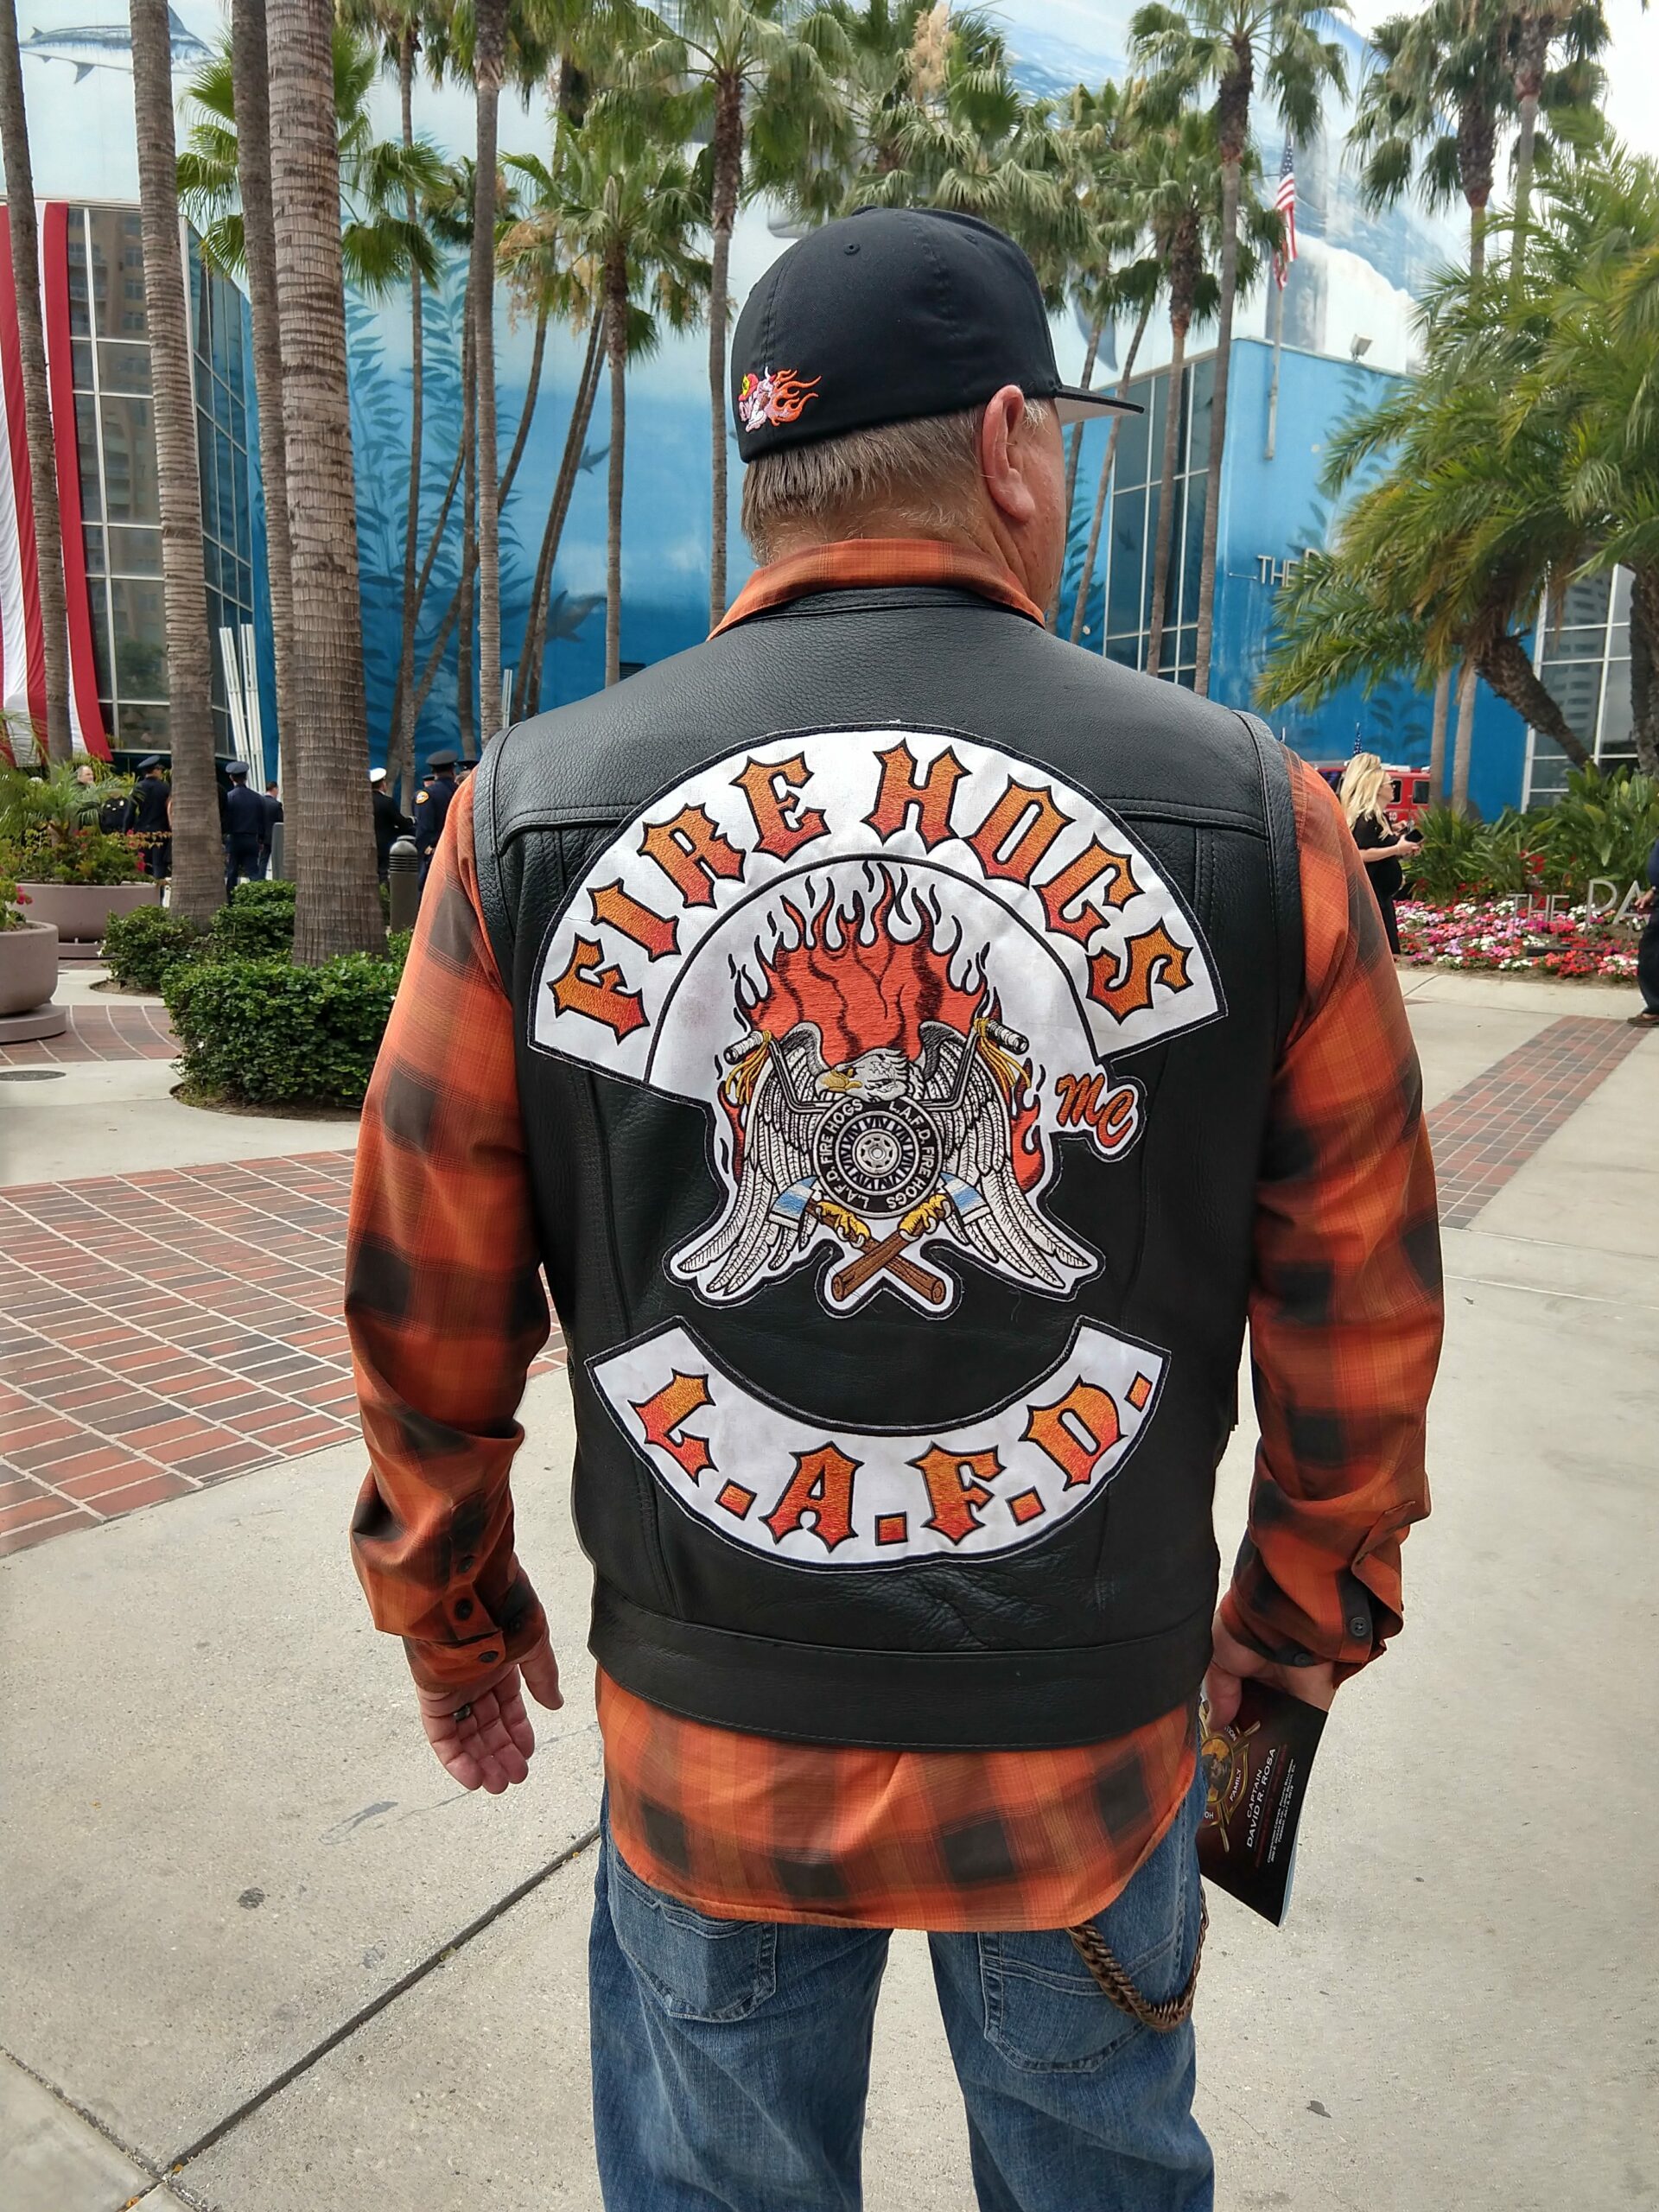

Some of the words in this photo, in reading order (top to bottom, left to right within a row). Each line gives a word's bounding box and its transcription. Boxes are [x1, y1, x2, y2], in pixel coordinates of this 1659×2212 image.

[1257, 555, 1299, 588] THE
[546, 751, 830, 1045] FIRE
[864, 738, 1194, 1025] HOGS
[1506, 893, 1570, 923] THE
[825, 1099, 863, 1134] HOGS
[819, 1134, 834, 1165] FIRE
[918, 1147, 935, 1178] FIRE
[886, 1177, 926, 1209] HOGS
[627, 1368, 1154, 1554] L.A.F.D.
[1230, 1768, 1242, 1802] FAMILY
[1246, 1805, 1261, 1847] DAVID
[1256, 1789, 1265, 1802] R.
[1262, 1749, 1275, 1785] ROSA
[1247, 1769, 1262, 1818] CAPTAIN
